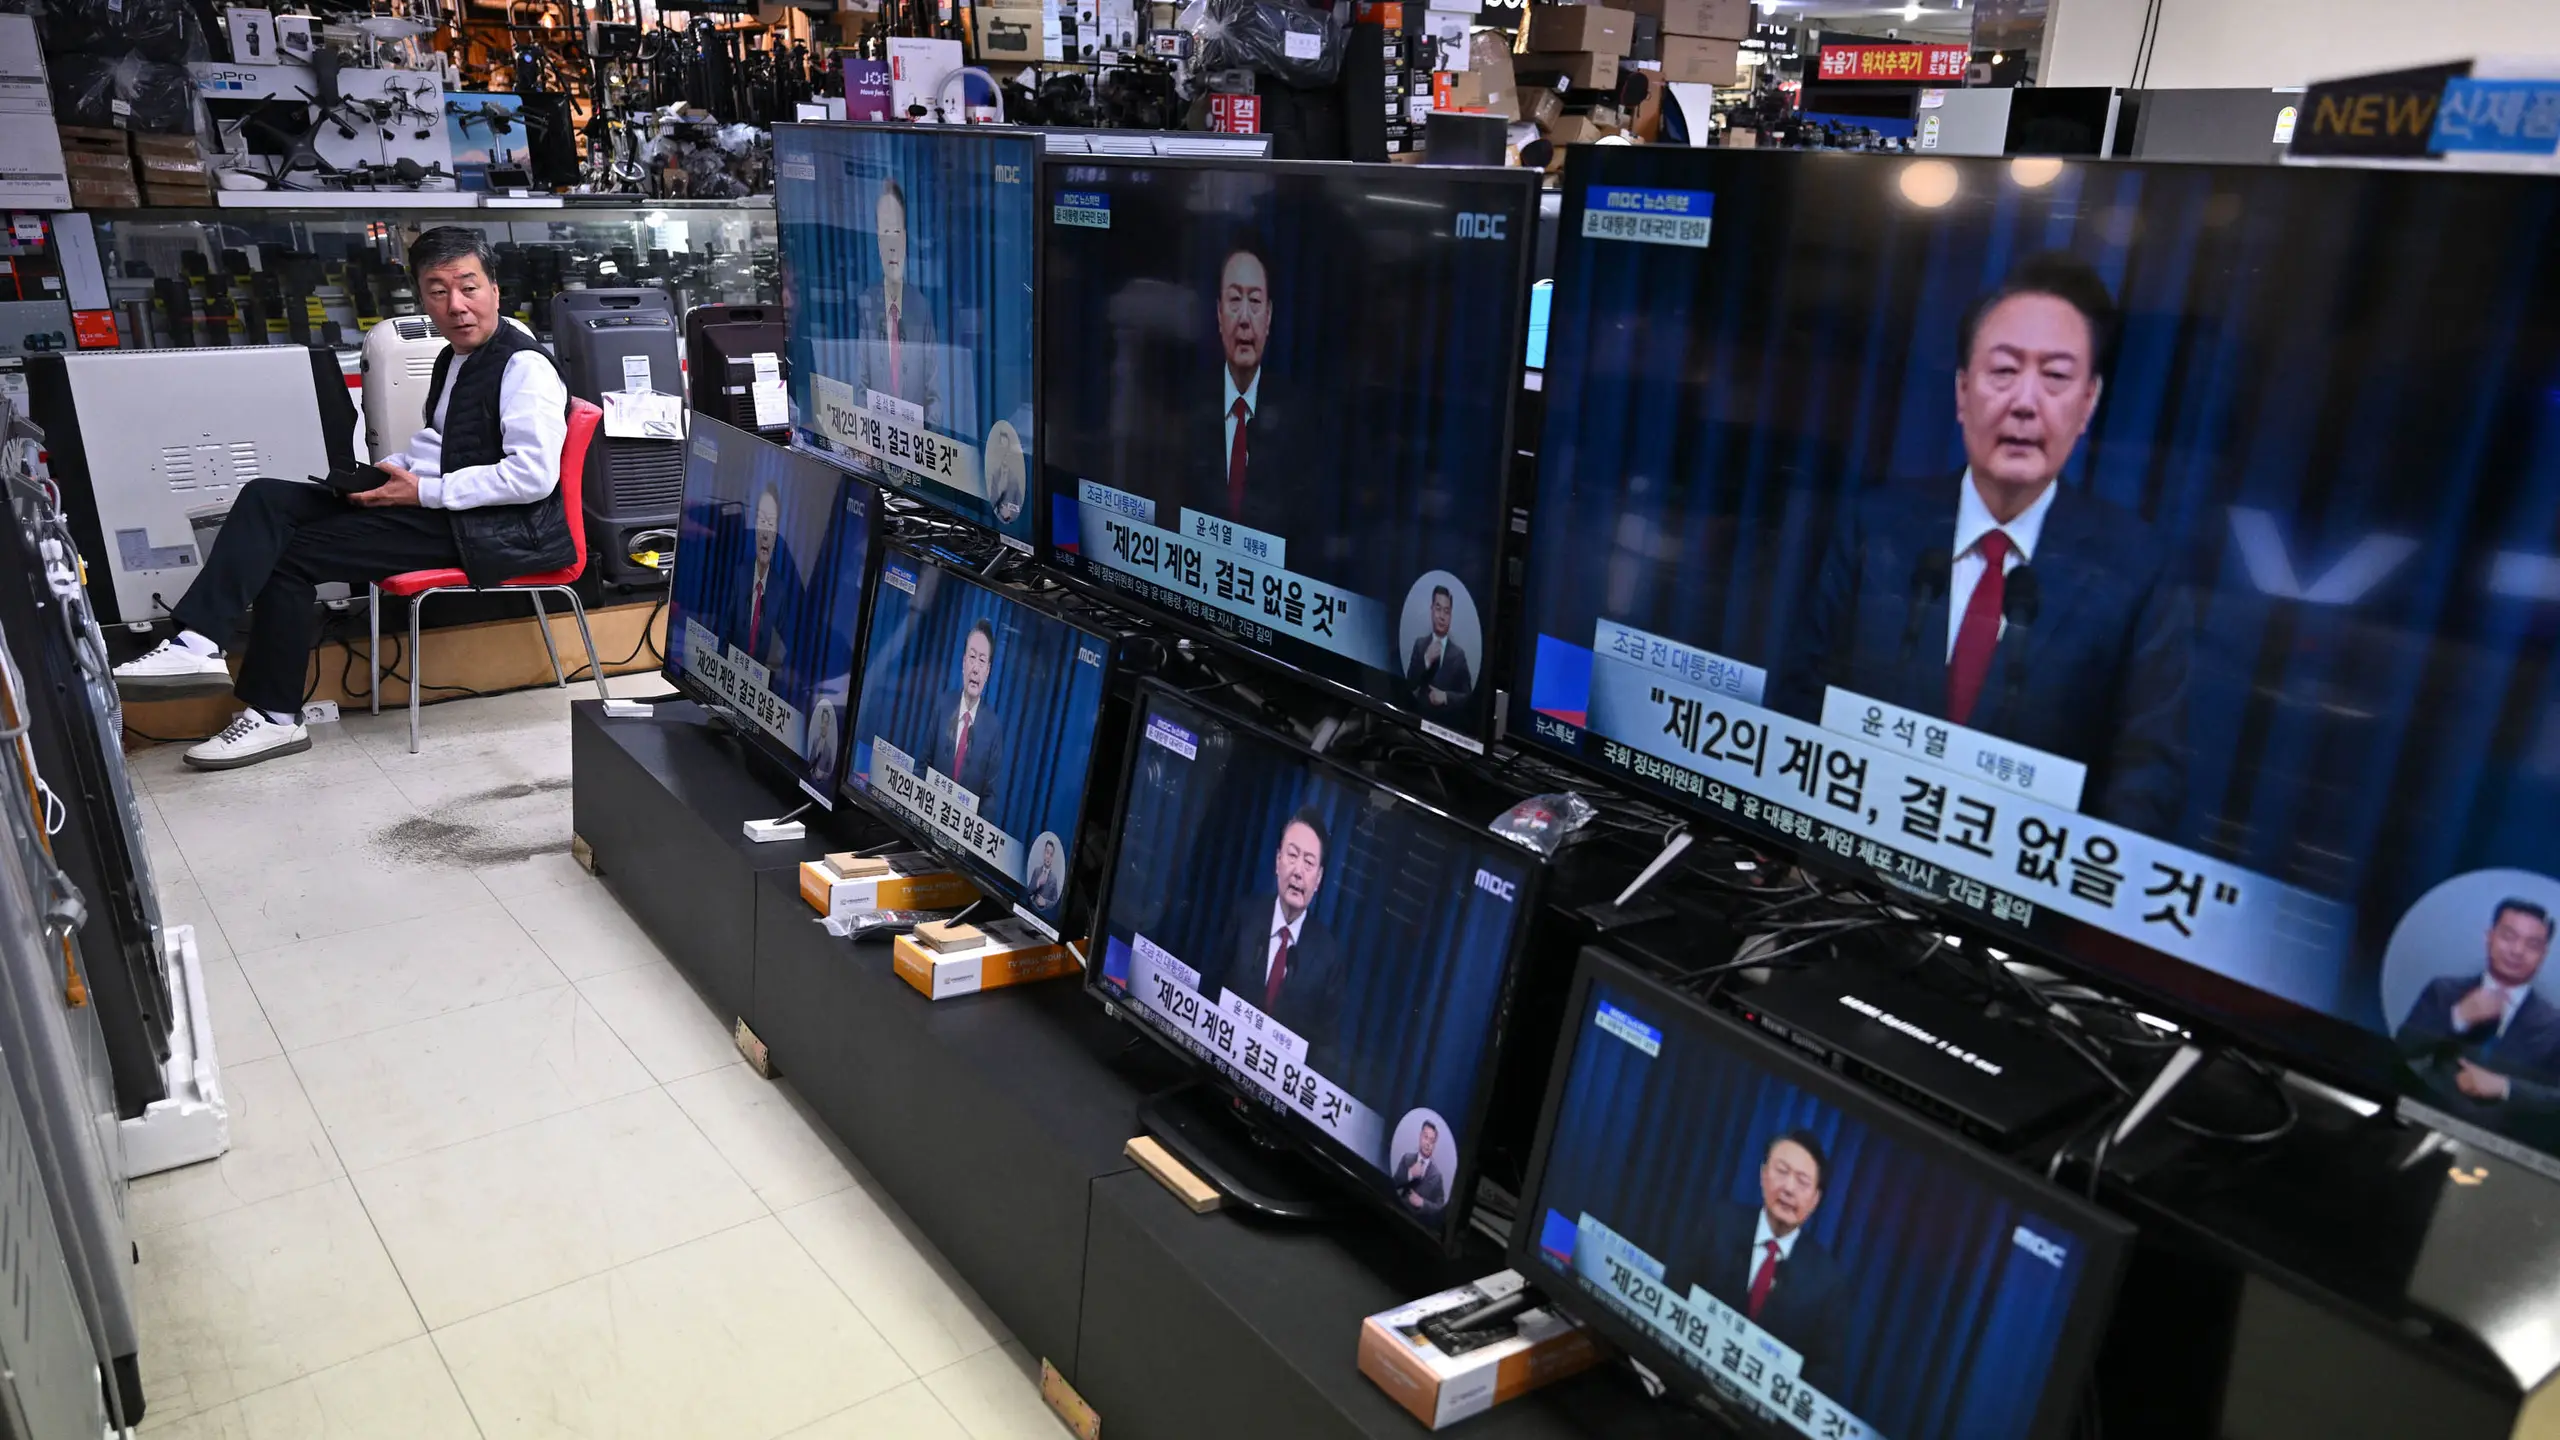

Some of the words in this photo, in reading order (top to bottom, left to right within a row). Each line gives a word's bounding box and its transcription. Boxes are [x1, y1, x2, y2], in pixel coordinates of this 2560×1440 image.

[203, 71, 256, 81] oPro
[1823, 50, 1857, 74] 녹음기
[1861, 50, 1923, 75] 위치추적기
[1948, 50, 1968, 75] 탐
[2313, 93, 2438, 136] NEW
[995, 165, 1020, 184] MBC
[1607, 191, 1642, 209] MBC
[1456, 212, 1506, 240] MBC
[1601, 215, 1637, 236] 대통령
[1640, 217, 1677, 239] 대국민
[1680, 220, 1707, 241] 담화
[860, 416, 886, 454] 계엄,
[888, 425, 911, 459] 결코
[913, 434, 937, 471] 없을
[940, 445, 958, 477] 것"
[846, 497, 865, 517] MBC
[1086, 484, 1103, 504] 조금
[1103, 490, 1113, 508] 전
[1113, 492, 1147, 517] 대통령실
[1243, 536, 1268, 558] 대통령
[1105, 520, 1158, 572] "제2의
[1164, 543, 1207, 594] 계엄,
[1215, 558, 1255, 605] 결코
[1262, 574, 1306, 626] 없을
[1311, 592, 1346, 638] 것"
[1087, 561, 1101, 579] 국회
[1101, 566, 1134, 592] 정보위원회
[1134, 580, 1149, 597] 오늘
[1184, 599, 1200, 617] 계엄
[1200, 604, 1216, 623] 체포
[1238, 619, 1254, 638] 긴급
[1255, 626, 1273, 646] 질의
[1078, 646, 1101, 668] MBC
[1612, 630, 1646, 658] 조금
[1650, 642, 1668, 668] 전
[1671, 647, 1744, 693] 대통령실
[719, 665, 737, 701] 계엄,
[739, 678, 756, 709] 결코
[757, 691, 774, 725] 없을
[1535, 716, 1576, 745] 뉴스특보
[1975, 749, 2037, 789] 대통령
[914, 784, 937, 820] 계엄,
[940, 800, 961, 832] 결코
[962, 815, 984, 849] 없을
[986, 830, 1005, 858] 것"
[1650, 687, 1768, 778] "제2의
[1778, 735, 1878, 825] 계엄,
[1900, 775, 1996, 858] 결코
[2015, 816, 2125, 908] 없을
[2142, 861, 2240, 938] 것"
[1603, 741, 1631, 769] 국회
[1633, 754, 1702, 798] 정보위원회
[1705, 781, 1737, 809] 오늘
[1856, 840, 1893, 871] 체포
[1947, 875, 1987, 910] 긴급
[1990, 890, 2033, 928] 질의
[1475, 868, 1516, 901] MBC
[1140, 940, 1155, 960] 조금
[1153, 972, 1199, 1029] "제2의
[1201, 1009, 1237, 1059] 계엄,
[1244, 1036, 1279, 1081] 결코
[1282, 1063, 1318, 1111] 없을
[1321, 1090, 1352, 1128] 것"
[1666, 1299, 1713, 1357] 계엄,
[1721, 1337, 1765, 1388] 결코
[1770, 1372, 1815, 1427] 없을
